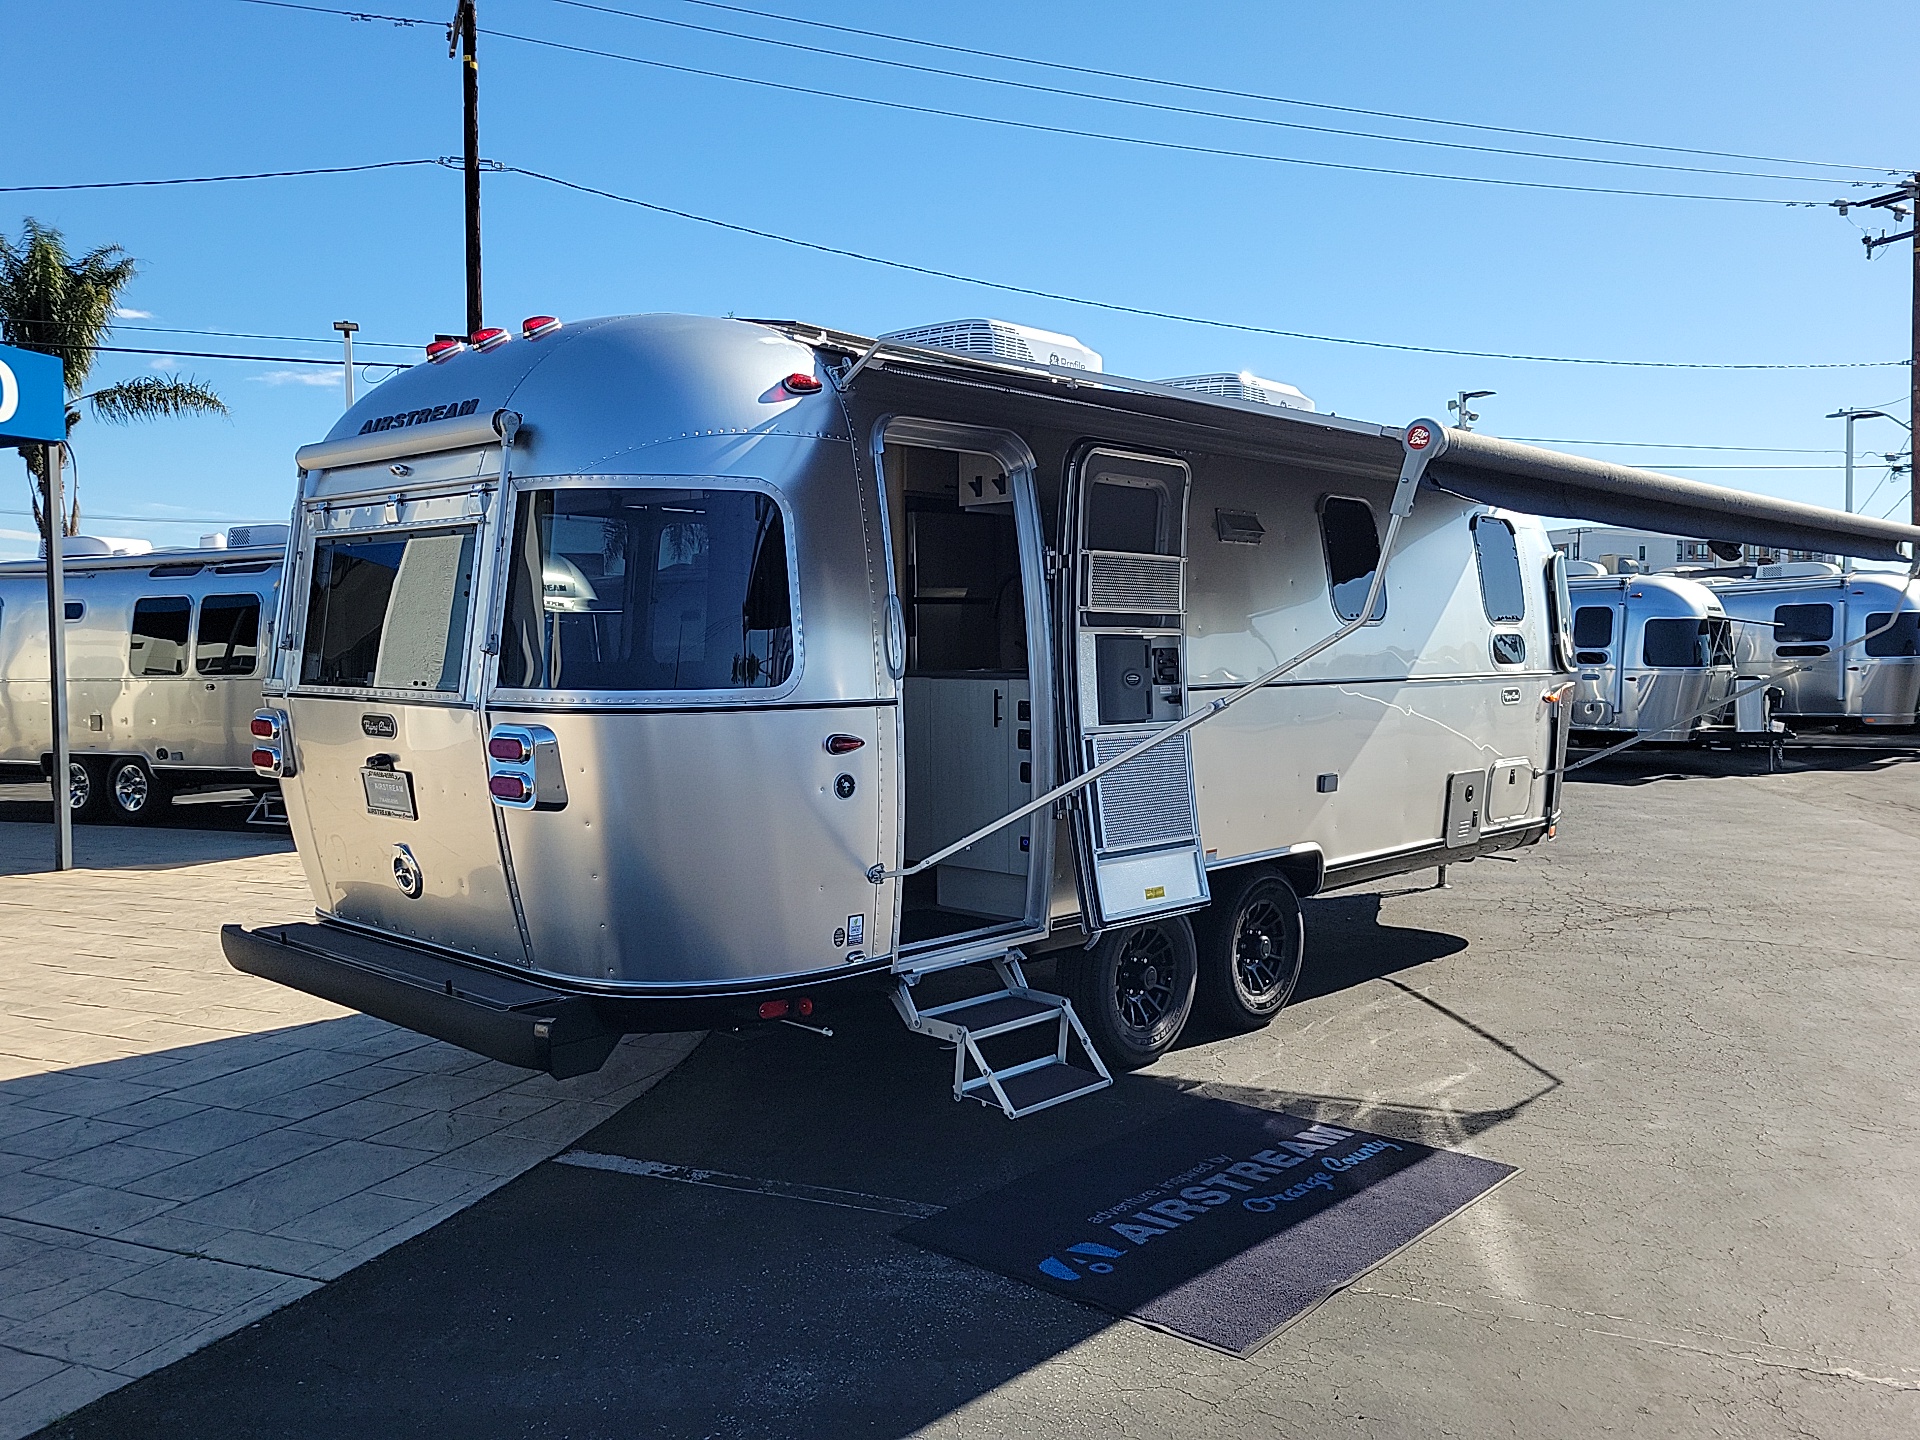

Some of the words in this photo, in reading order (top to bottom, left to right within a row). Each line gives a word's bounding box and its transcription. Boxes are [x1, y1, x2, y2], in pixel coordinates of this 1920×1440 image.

[358, 398, 480, 435] AIRSTREAM
[1412, 428, 1429, 439] Zip
[1110, 1124, 1355, 1246] AIRSTREAM
[1243, 1172, 1334, 1213] Orange
[1321, 1139, 1403, 1172] County
